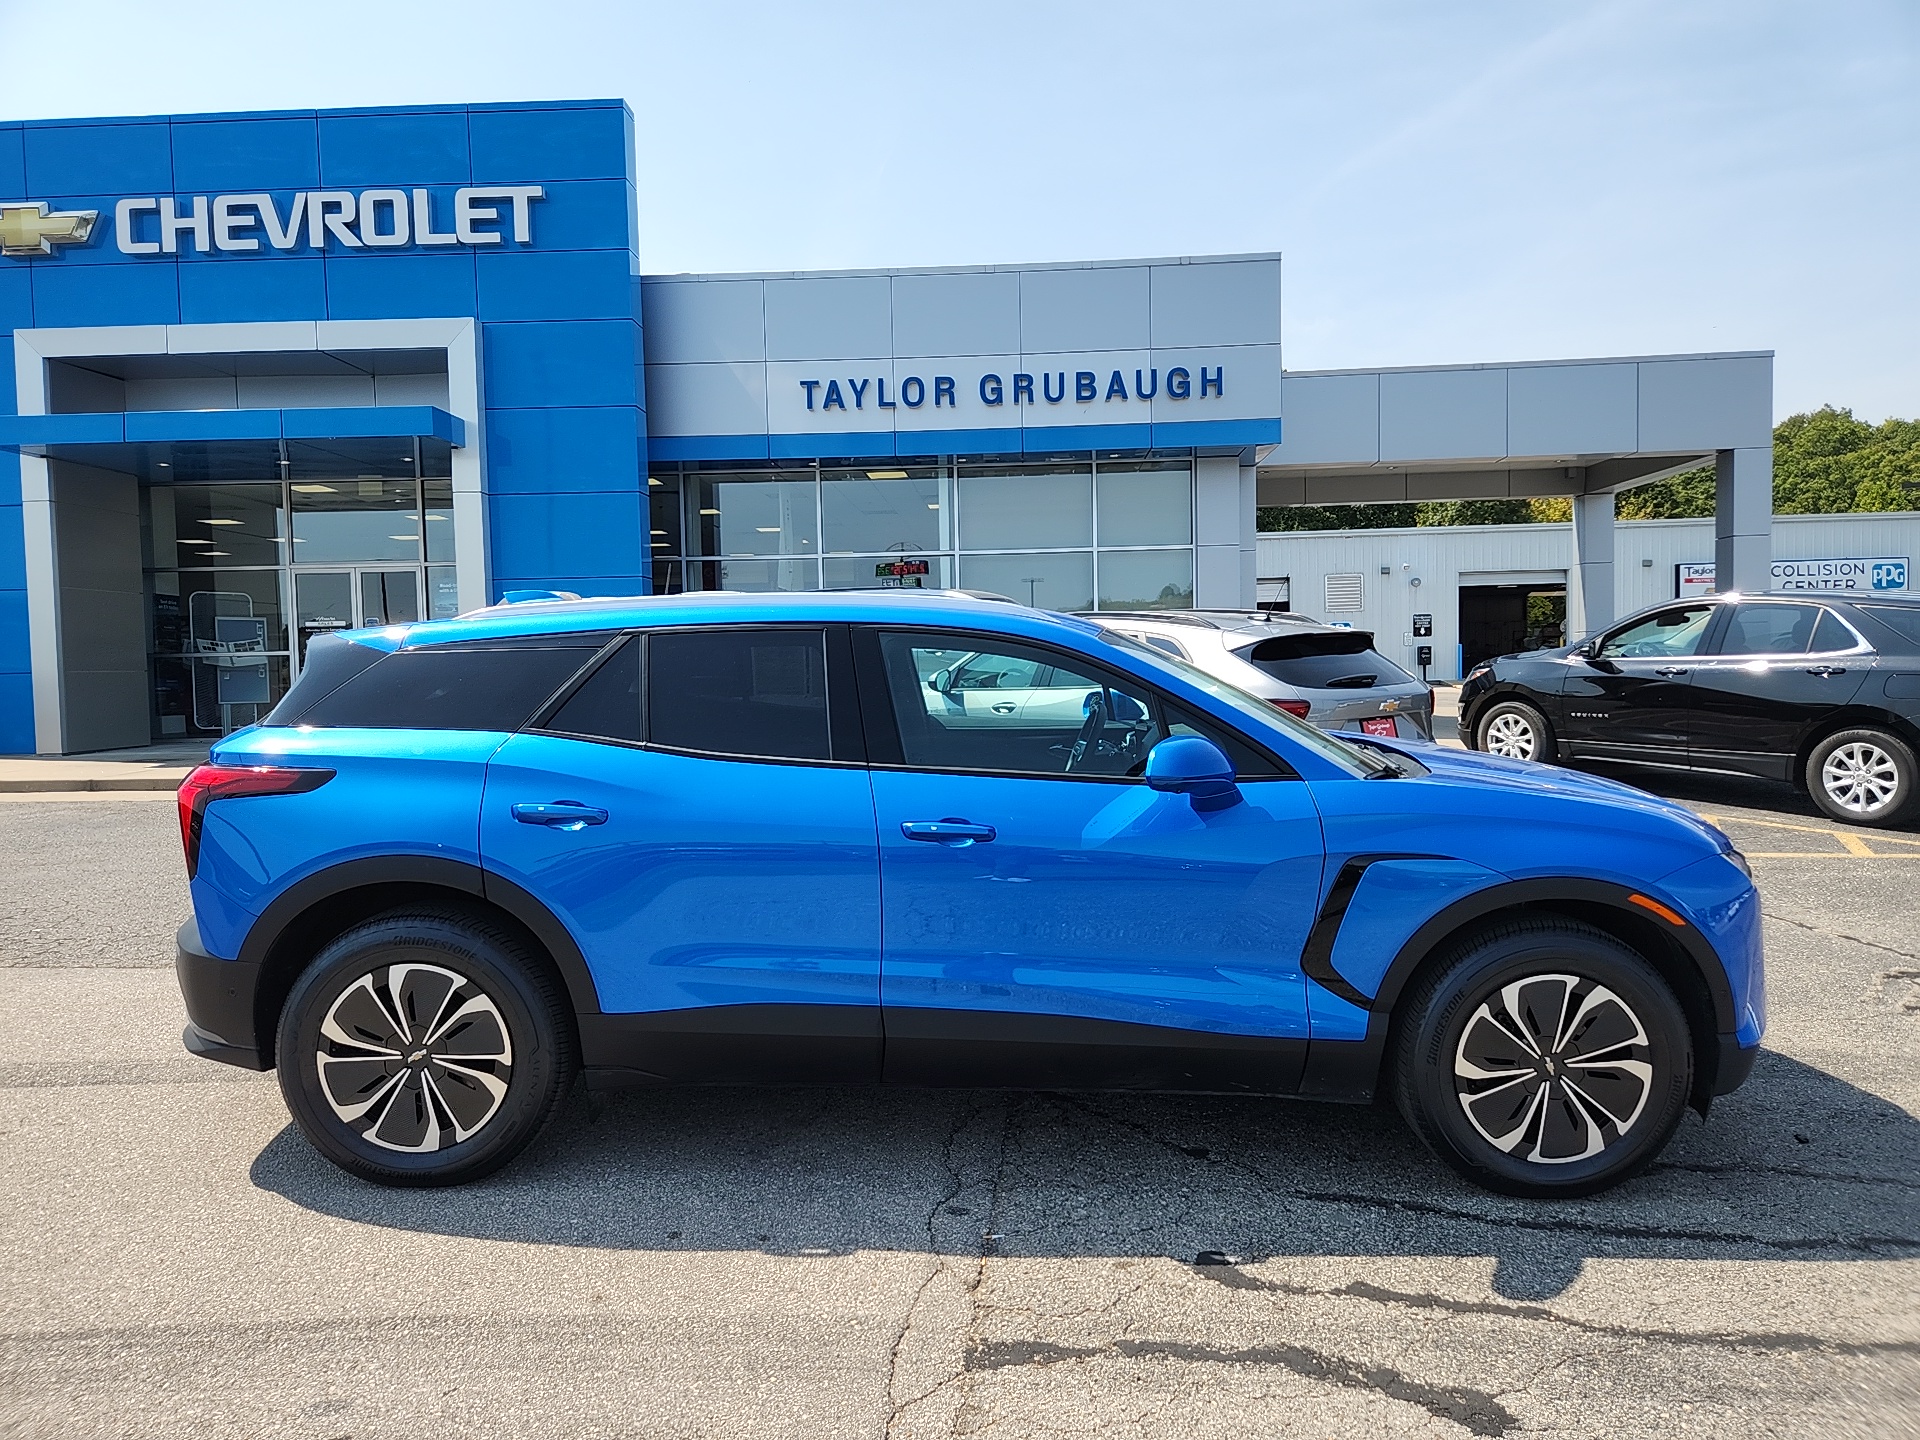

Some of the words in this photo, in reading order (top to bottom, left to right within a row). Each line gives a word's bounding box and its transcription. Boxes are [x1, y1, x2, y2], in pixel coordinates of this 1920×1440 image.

[115, 185, 545, 256] CHEVROLET
[799, 376, 957, 411] TAYLOR
[979, 365, 1225, 406] GRUBAUGH
[1684, 566, 1716, 577] Taylor
[1770, 563, 1865, 578] COLLISION
[1873, 565, 1904, 587] PPG
[1782, 578, 1857, 589] CENTER
[393, 935, 477, 961] BRIDGESTONE
[1427, 989, 1467, 1067] BRIDGESTONE
